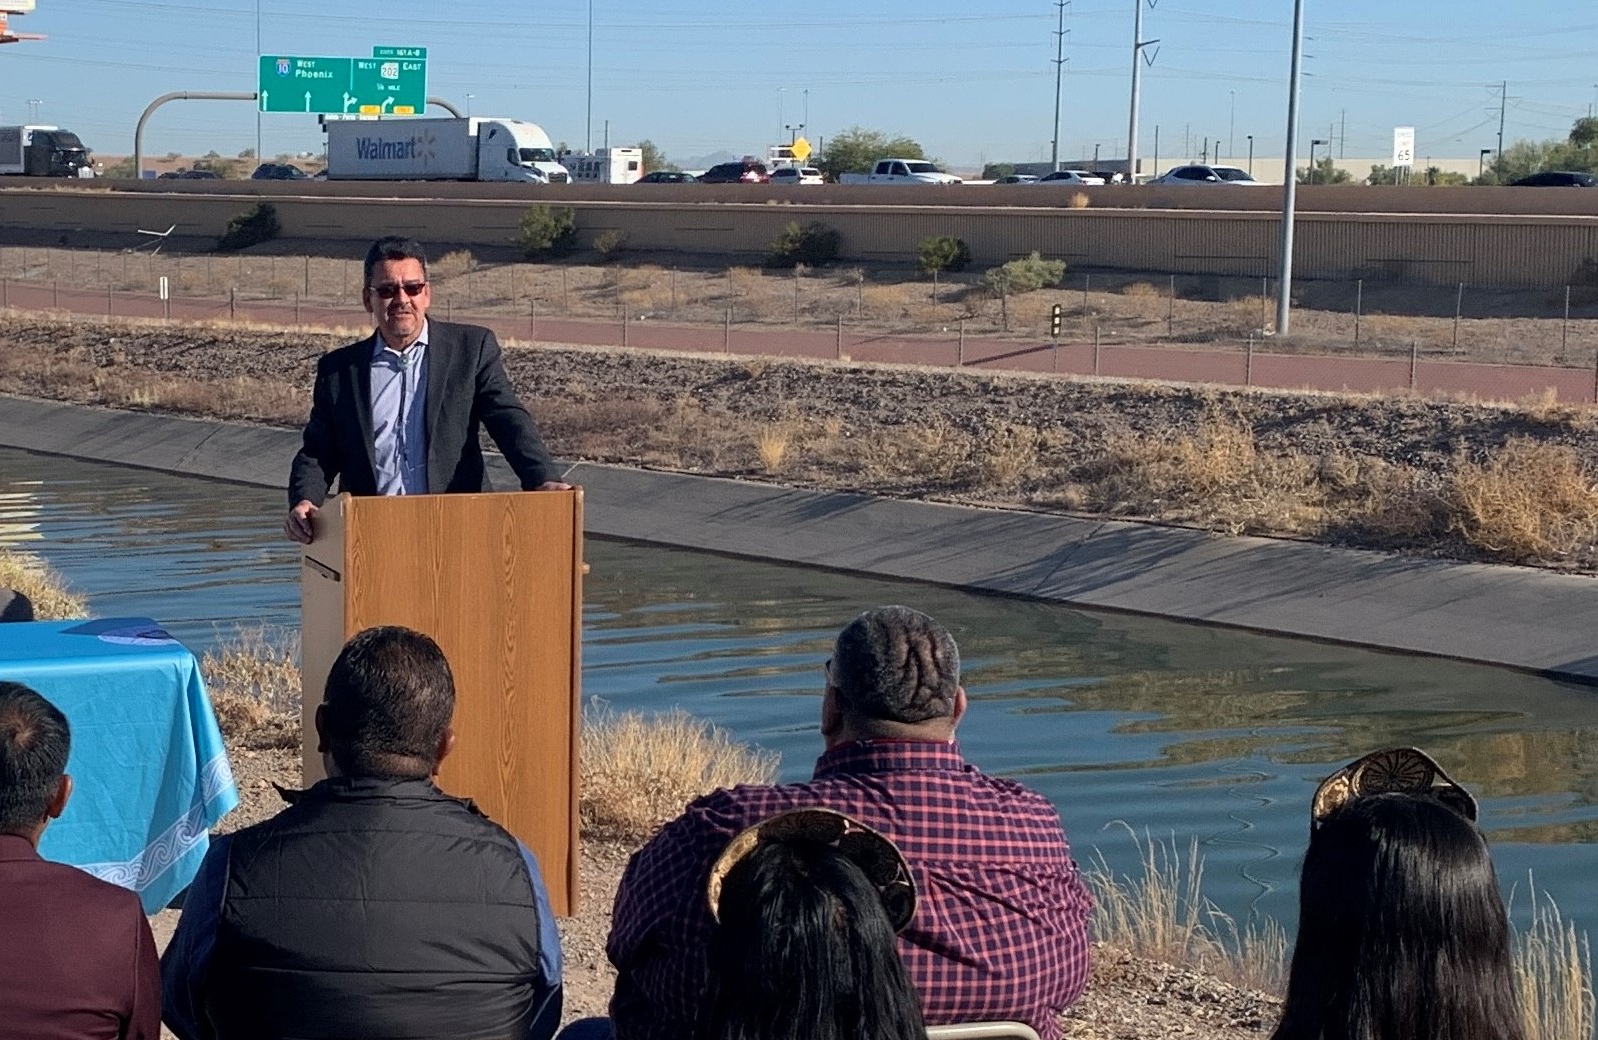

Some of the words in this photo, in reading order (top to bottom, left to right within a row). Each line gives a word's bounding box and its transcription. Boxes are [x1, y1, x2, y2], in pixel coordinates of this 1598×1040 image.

[403, 62, 421, 70] EAST
[295, 69, 333, 78] Phoenix
[382, 67, 397, 77] 202
[356, 136, 416, 160] Walmart
[1398, 150, 1410, 161] 65
